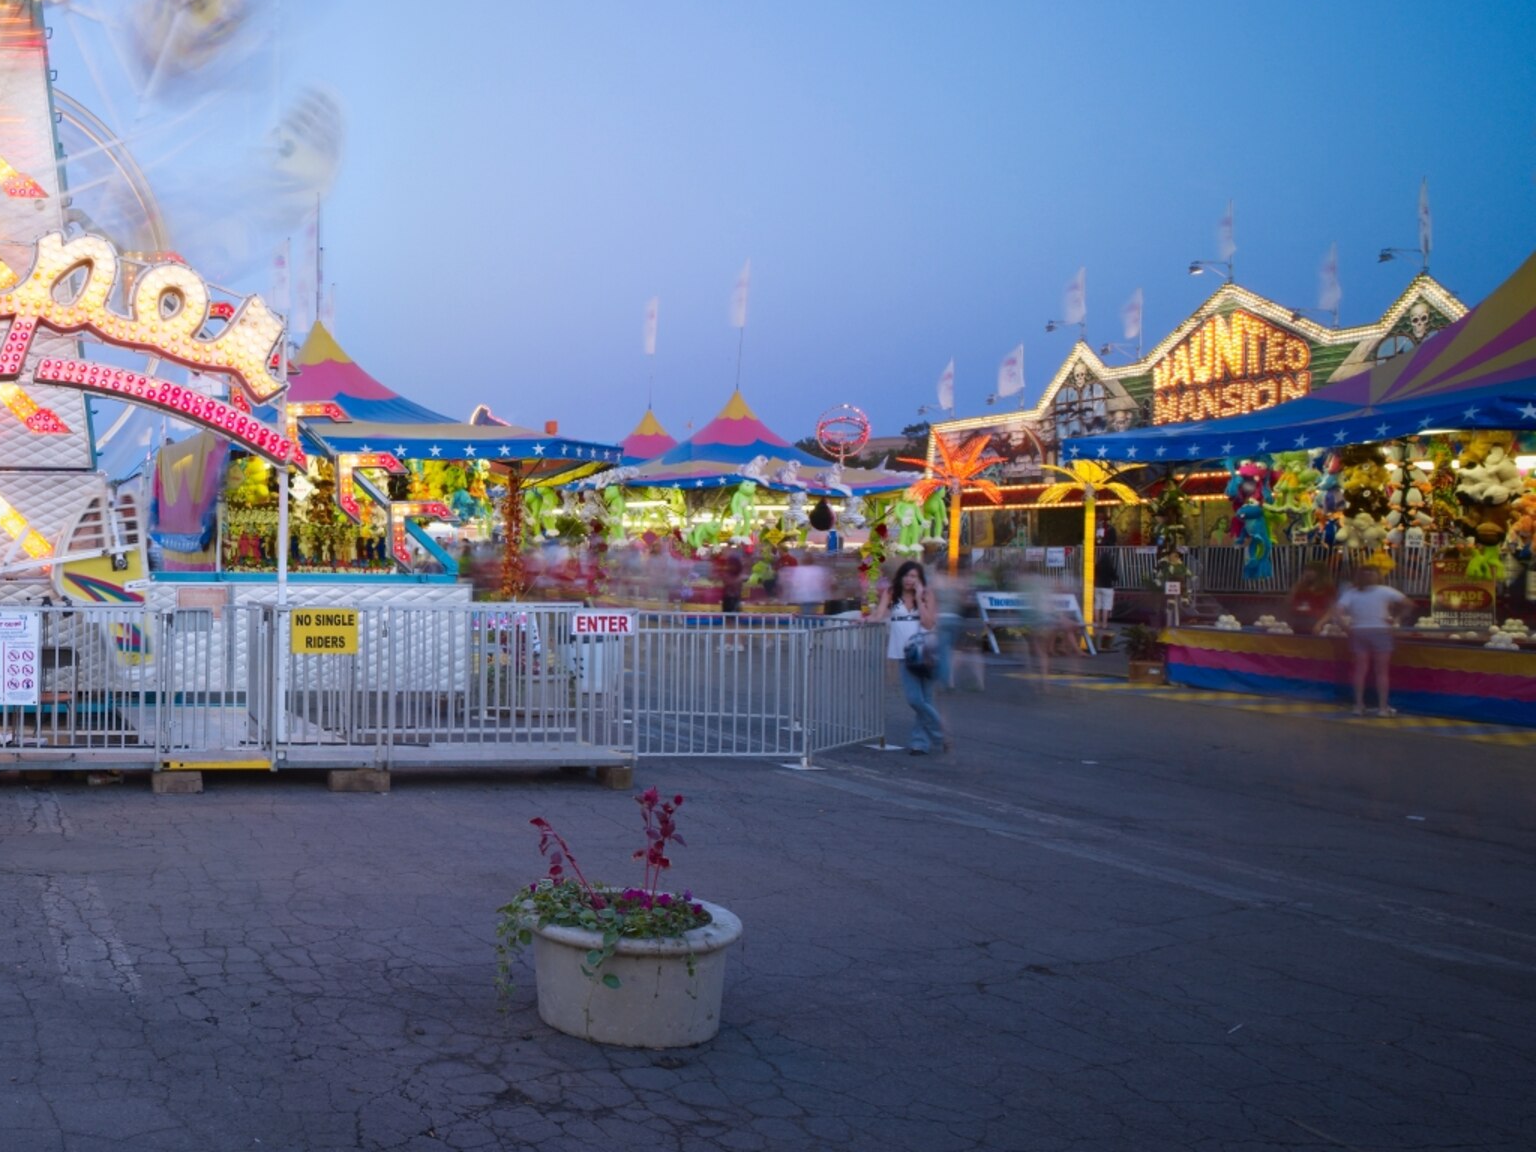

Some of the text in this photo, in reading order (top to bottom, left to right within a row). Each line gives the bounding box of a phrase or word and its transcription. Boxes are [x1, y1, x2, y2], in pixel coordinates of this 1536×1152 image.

[1153, 309, 1312, 391] HAUNTED
[1152, 370, 1312, 426] MANSION
[295, 614, 355, 627] NO SINGLE
[576, 615, 629, 633] ENTER
[305, 635, 346, 649] RIDERS
